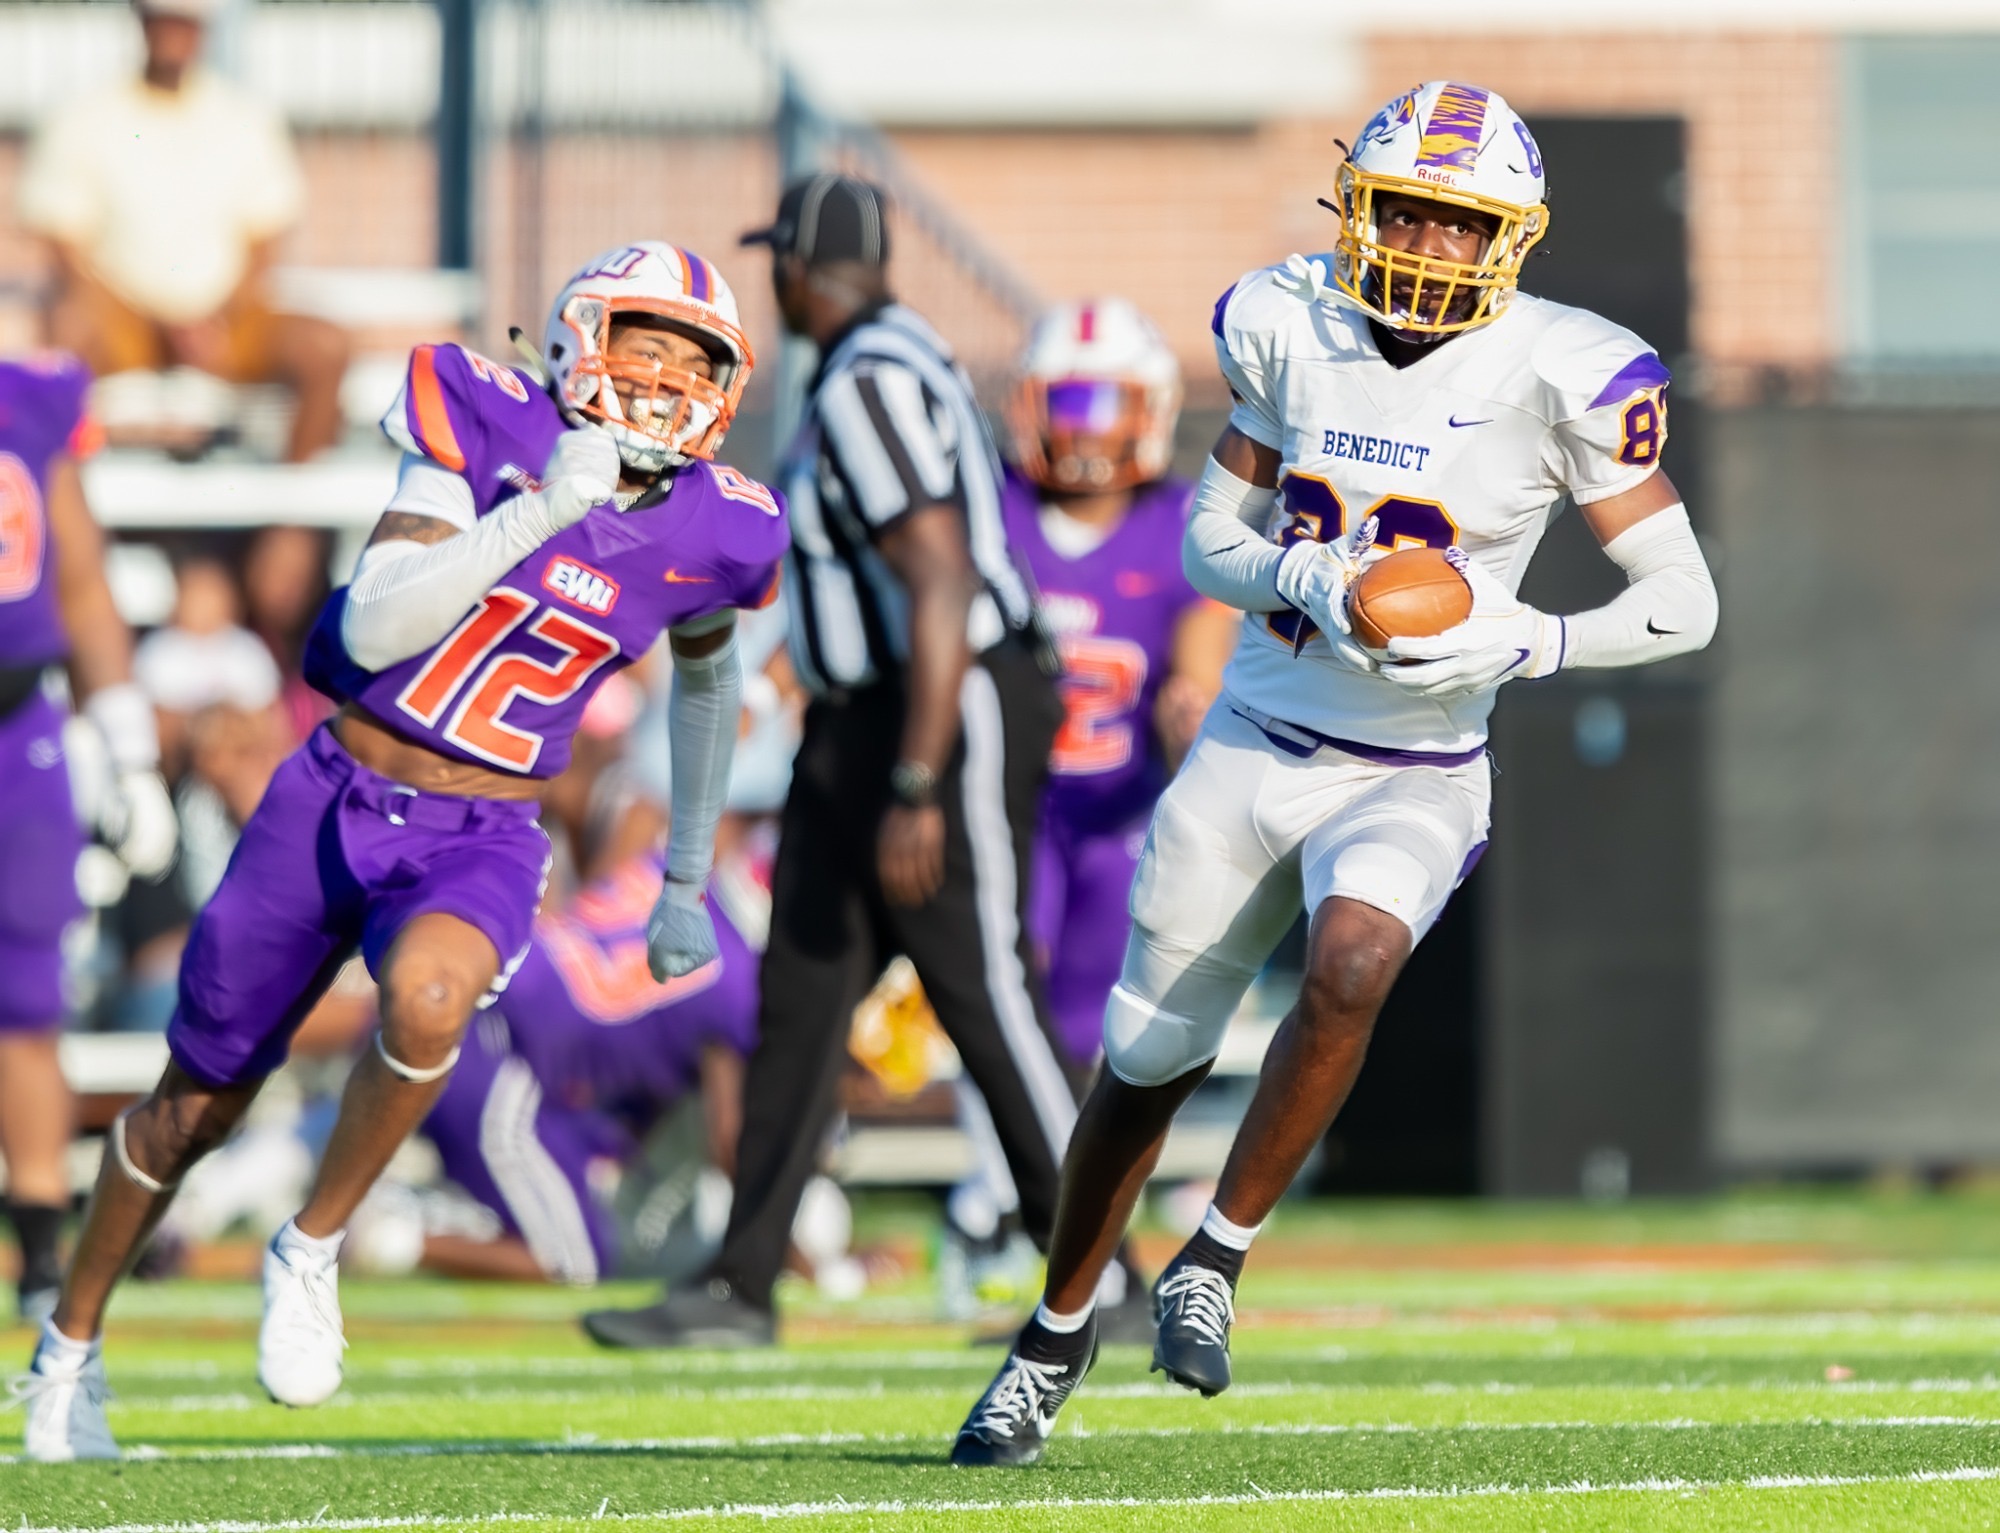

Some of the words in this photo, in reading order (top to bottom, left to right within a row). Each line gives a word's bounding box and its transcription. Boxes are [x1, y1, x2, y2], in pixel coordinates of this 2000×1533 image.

[1321, 429, 1430, 472] BENEDICT
[1611, 384, 1667, 469] 8
[545, 559, 616, 613] EWU
[395, 585, 622, 775] 12
